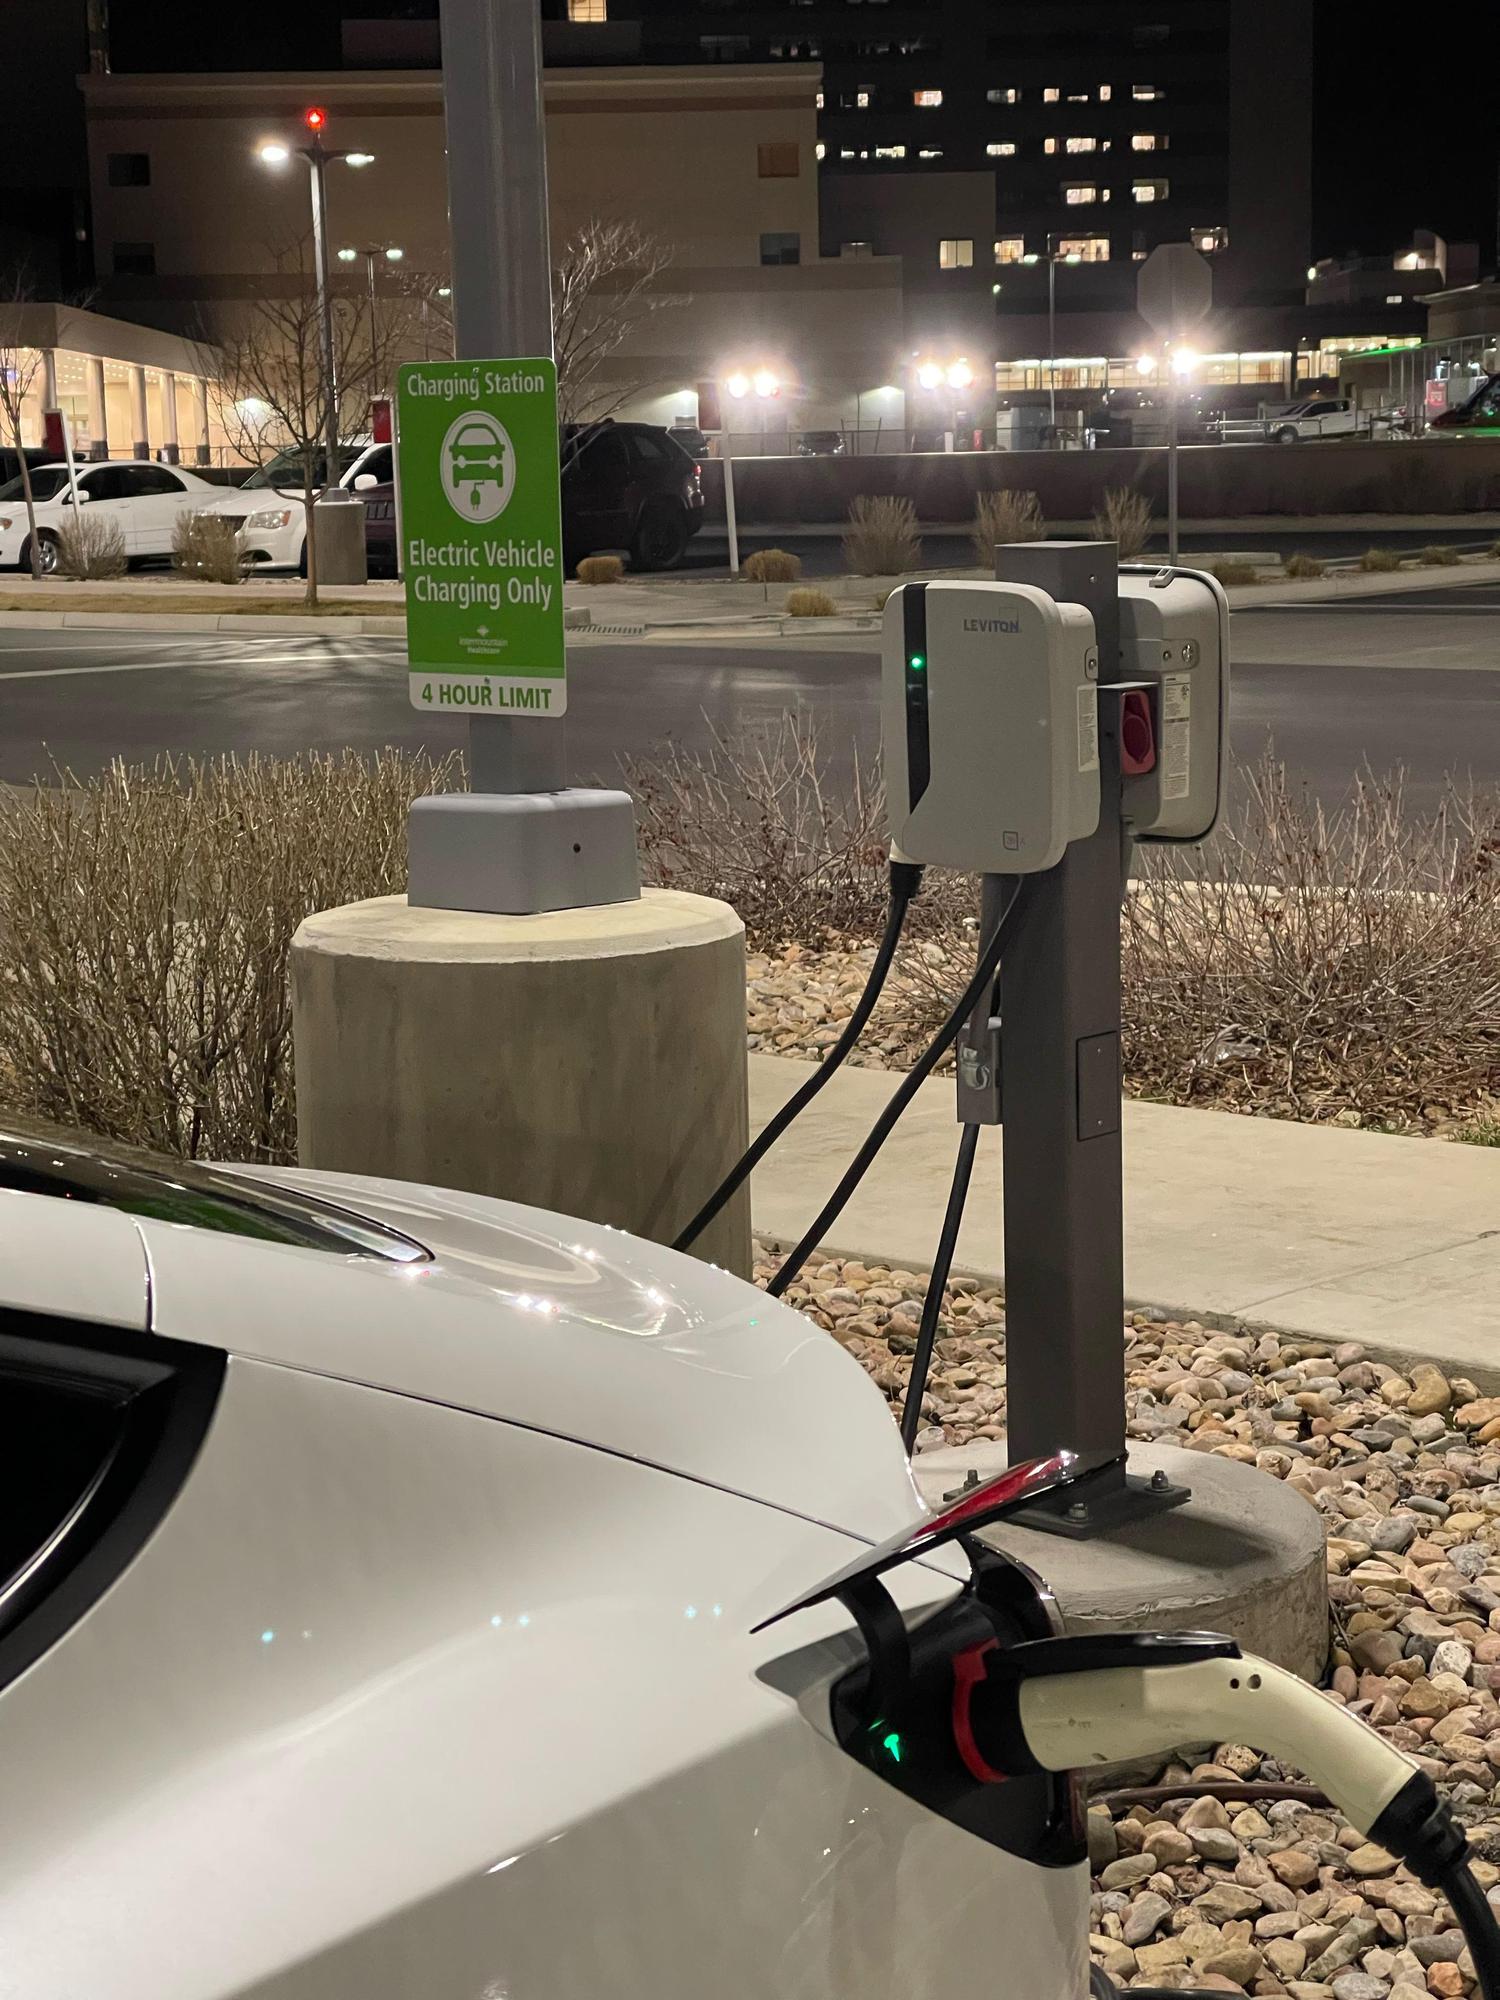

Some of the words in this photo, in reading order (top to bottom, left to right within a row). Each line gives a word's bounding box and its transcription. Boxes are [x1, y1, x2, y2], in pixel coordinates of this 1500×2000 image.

[407, 372, 480, 401] Charging
[484, 370, 545, 395] Station
[409, 538, 480, 567] Electric
[483, 538, 555, 568] Vehicle
[414, 574, 500, 611] Charging
[507, 576, 552, 612] Only
[963, 618, 1019, 634] LEVITON
[421, 682, 433, 703] 4
[439, 683, 492, 706] HOUR
[499, 686, 552, 709] LIMIT
